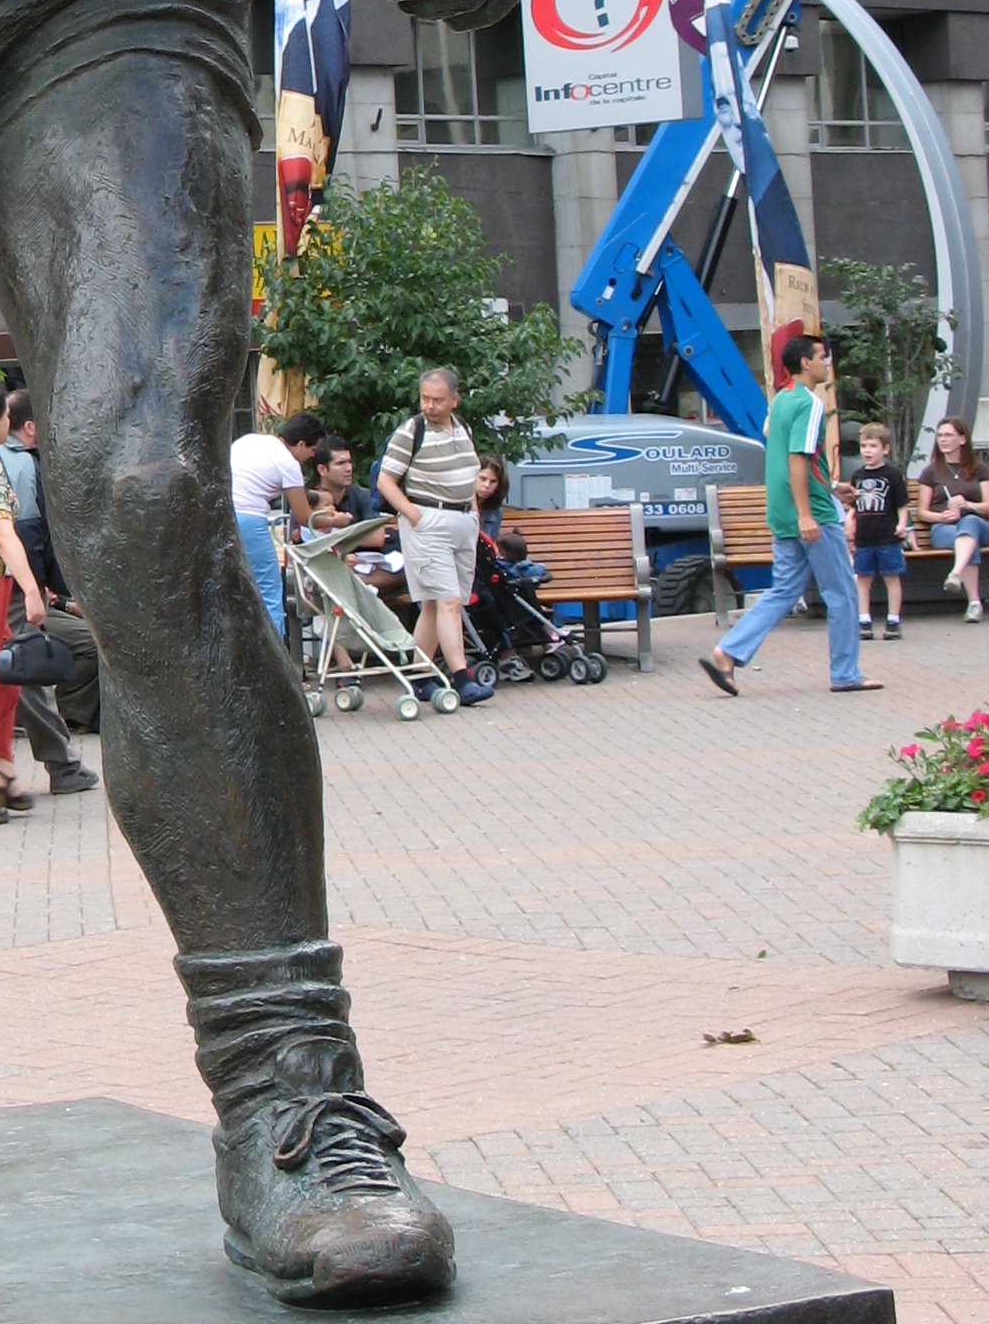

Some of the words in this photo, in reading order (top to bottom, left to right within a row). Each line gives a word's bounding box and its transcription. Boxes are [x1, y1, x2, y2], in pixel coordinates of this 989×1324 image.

[588, 72, 617, 81] Capital
[612, 94, 646, 104] capitale
[518, 431, 730, 468] SOULARD
[670, 462, 739, 476] Multi-Service
[668, 503, 706, 515] 0608
